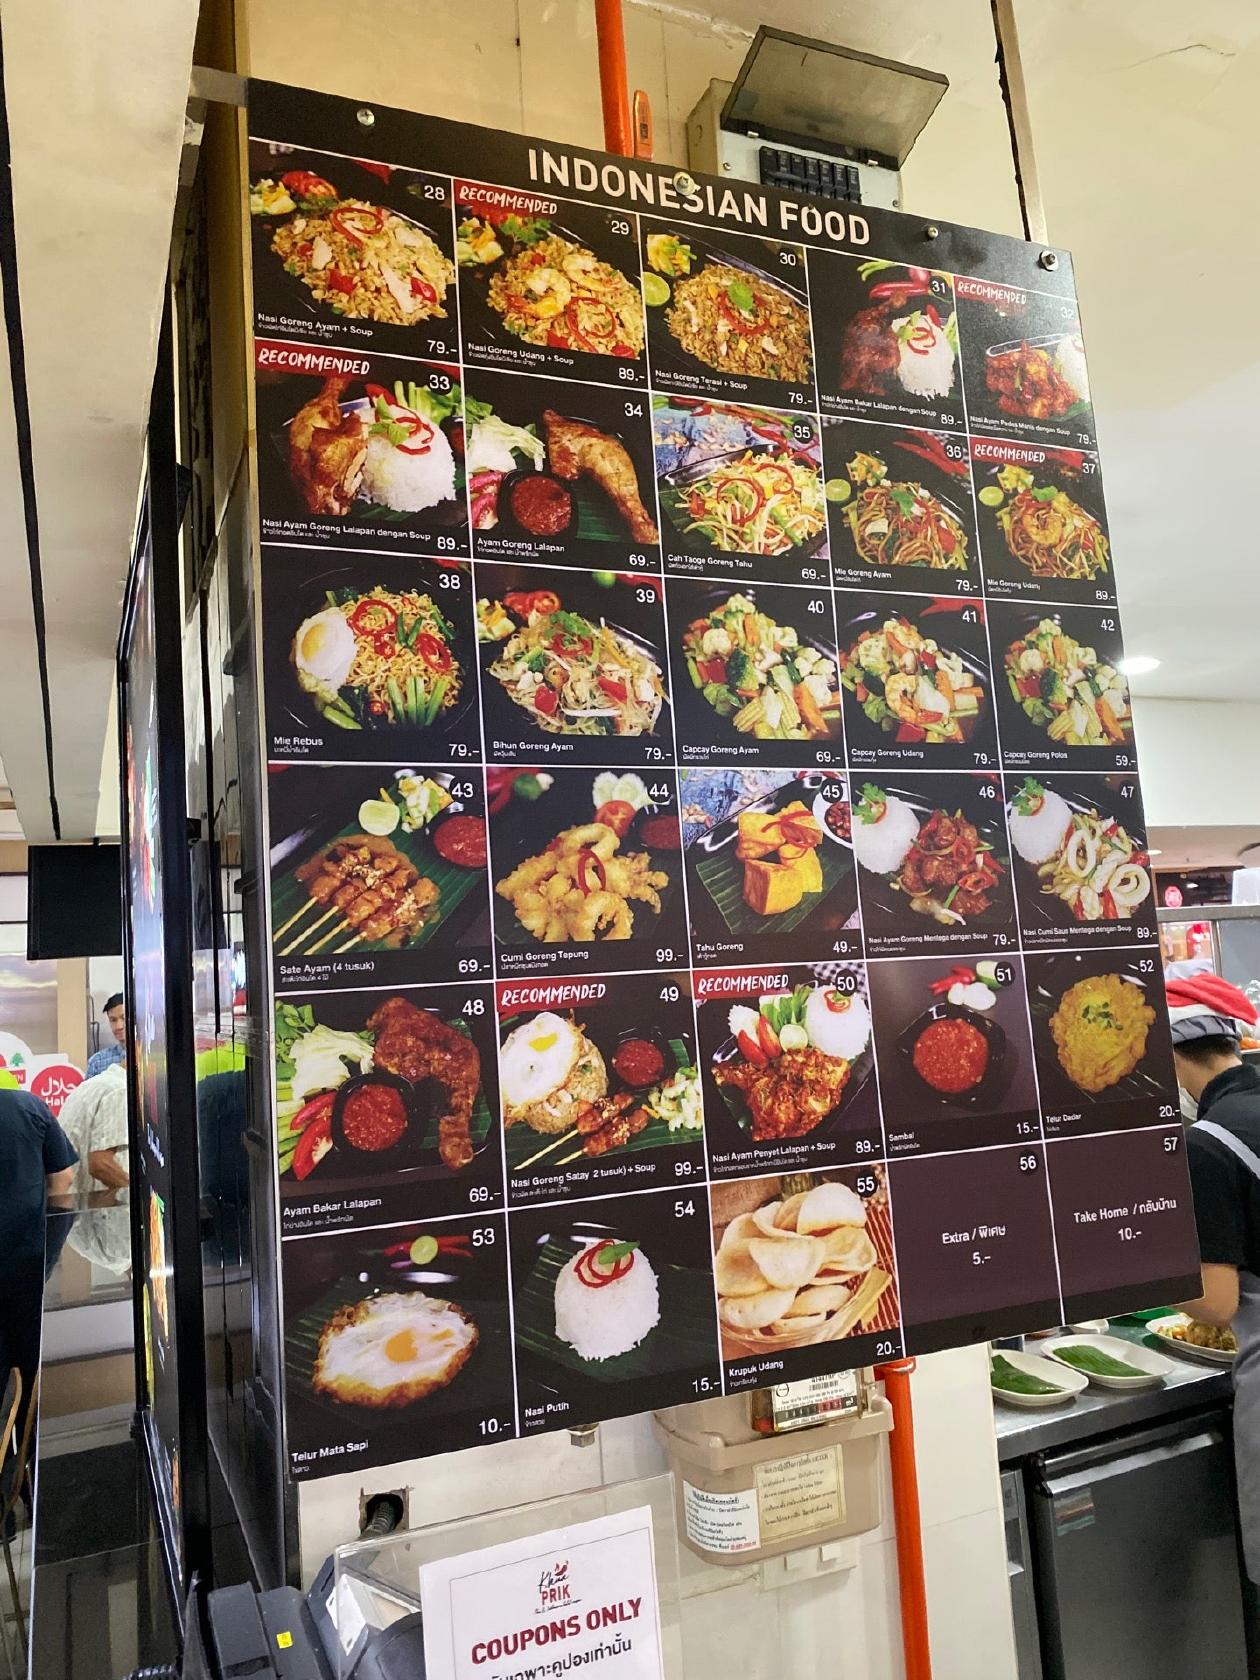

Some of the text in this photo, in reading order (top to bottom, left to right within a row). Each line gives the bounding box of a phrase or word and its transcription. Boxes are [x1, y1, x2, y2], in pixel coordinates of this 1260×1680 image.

[424, 184, 445, 201] 28
[459, 185, 558, 215] RECOMMENDED
[528, 148, 870, 245] INDONESIAN FOOD
[611, 220, 630, 235] 29
[779, 252, 796, 266] 30
[931, 280, 946, 294] 31
[957, 281, 1027, 305] RECOMMENDED
[257, 312, 278, 323] Nasi
[279, 316, 313, 330] Goreng
[315, 321, 340, 332] Ayam
[349, 325, 374, 337] Soup
[427, 339, 458, 355] 79.-
[467, 342, 487, 352] Nasi
[487, 345, 518, 358] Goreng
[519, 349, 545, 362] Udang
[553, 354, 574, 366] Soup
[258, 347, 370, 375] RECOMMENDED
[429, 374, 450, 390] 33
[618, 367, 645, 382] 89.-
[655, 369, 672, 379] Nasi
[672, 372, 700, 384] Goreng
[729, 380, 748, 391] Soup
[788, 391, 813, 405] 79.-
[624, 402, 643, 418] 34
[940, 413, 963, 426] 89.-
[793, 425, 811, 439] 35
[1076, 433, 1097, 445] 79.-
[946, 444, 962, 459] 36
[974, 443, 1046, 463] RECOMMENDED
[1082, 462, 1096, 474] 37
[262, 518, 282, 528] Nasi
[283, 520, 308, 530] Ayam
[309, 522, 341, 535] Goreng
[342, 525, 376, 536] Lalapan
[376, 528, 408, 539] dengan
[409, 531, 431, 542] Soup
[437, 536, 468, 551] 89.-
[477, 537, 501, 548] Ayam
[501, 539, 532, 551] Goreng
[534, 542, 565, 553] Lalapan
[629, 554, 656, 567] 69.-
[667, 554, 683, 562] Cah
[707, 556, 734, 568] Goreng
[734, 559, 753, 568] Tahu
[439, 573, 461, 590] 38
[801, 568, 826, 580] 69.-
[872, 570, 892, 579] Ayam
[955, 579, 979, 592] 79.-
[635, 588, 656, 604] 39
[1095, 590, 1116, 601] 89.-
[807, 600, 825, 614] 40
[962, 610, 977, 623] 41
[1100, 618, 1115, 632] 42
[274, 736, 324, 746] Mie Rebus
[493, 740, 574, 752] Bihun Goreng Ayam
[448, 743, 480, 757] 79.-
[644, 747, 672, 760] 79.-
[682, 744, 760, 755] Capcay Goreng Ayam
[815, 750, 841, 763] 69.-
[851, 748, 924, 759] Capcay Goreng Udang
[973, 752, 997, 765] 79.-
[1115, 754, 1137, 766] 59.-
[451, 782, 474, 798] 43
[649, 783, 670, 798] 44
[822, 784, 840, 799] 45
[978, 785, 996, 799] 46
[1120, 786, 1135, 798] 47
[992, 933, 1016, 946] 79.-
[1136, 926, 1158, 939] 89.-
[695, 942, 744, 952] Tahu Goreng
[832, 940, 858, 953] 49.-
[500, 950, 589, 963] Cumi Goreng Tepung
[655, 948, 684, 963] 99.-
[280, 961, 375, 975] Sate Ayam (4 tusuk)
[458, 959, 491, 973] 69.-
[1139, 959, 1155, 973] 52
[996, 967, 1012, 982] 51
[697, 974, 789, 995] RECOMMENDED
[837, 976, 855, 991] 50
[501, 983, 606, 1007] RECOMMENDED
[659, 986, 679, 1002] 49
[462, 998, 485, 1016] 48
[1045, 1113, 1082, 1124] Telur Dadar
[1159, 1104, 1181, 1118] 20.-
[1016, 1121, 1039, 1135] 15.-
[888, 1131, 915, 1142] Sambal
[1163, 1136, 1178, 1152] 57
[712, 1142, 836, 1163] Nasi Ayam Penyet Lalapan Soup
[855, 1139, 881, 1154] 89.-
[674, 1161, 704, 1177] 99.-
[1020, 1155, 1037, 1171] 56
[511, 1179, 530, 1188] Nasi
[532, 1175, 565, 1186] Goreng
[565, 1172, 590, 1181] Satay
[600, 1165, 627, 1177] tusuk)
[634, 1164, 656, 1173] Soup
[857, 1176, 875, 1193] 55
[469, 1186, 502, 1203] 69.-
[283, 1198, 382, 1218] Ayam Bakar Lalapan
[674, 1200, 695, 1218] 54
[1074, 1197, 1177, 1224] Take Home กลับบ้าน
[472, 1227, 495, 1247] 53
[942, 1224, 1007, 1245] Extra พิเศษ
[1118, 1227, 1142, 1242] 10.-
[972, 1252, 991, 1266] 5.-
[876, 1341, 901, 1356] 20.-
[728, 1360, 784, 1377] Krupuk Udang
[692, 1377, 721, 1393] 15.-
[524, 1402, 570, 1418] Nasi Putih
[479, 1418, 511, 1435] 10.-
[291, 1441, 369, 1462] Telur Mata Sapi
[541, 1584, 571, 1606] PRIK
[471, 1597, 642, 1665] COUPONS ONLY
